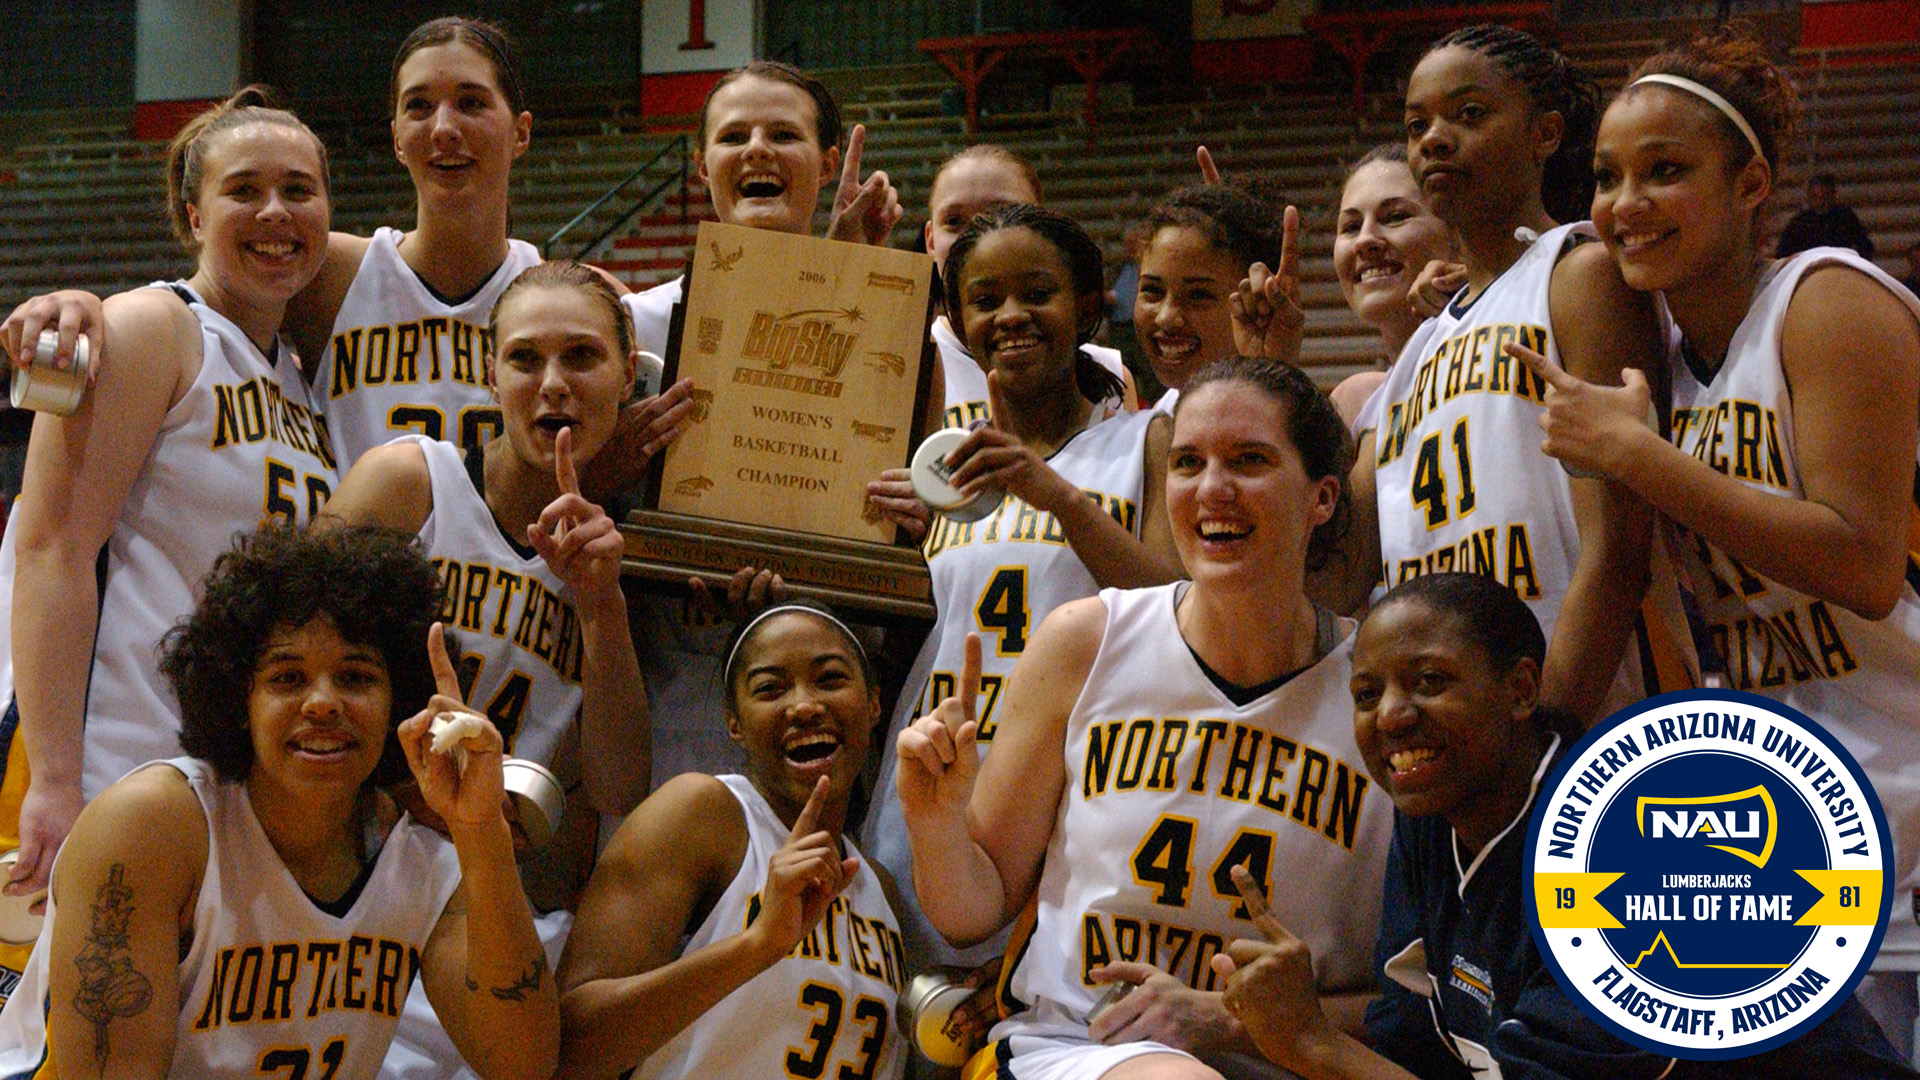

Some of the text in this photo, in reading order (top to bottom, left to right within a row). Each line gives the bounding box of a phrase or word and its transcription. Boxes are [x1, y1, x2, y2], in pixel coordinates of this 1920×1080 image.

[798, 270, 827, 285] 2006
[732, 435, 842, 464] BASKETBALL
[751, 405, 833, 430] WOMEN'S
[737, 467, 830, 493] CHAMPION
[1410, 416, 1477, 532] 41
[973, 564, 1032, 657] 4
[1083, 717, 1370, 853] NORTHERN
[1129, 812, 1278, 920] 44
[1081, 911, 1228, 993] ARIZO
[783, 978, 891, 1080] 33
